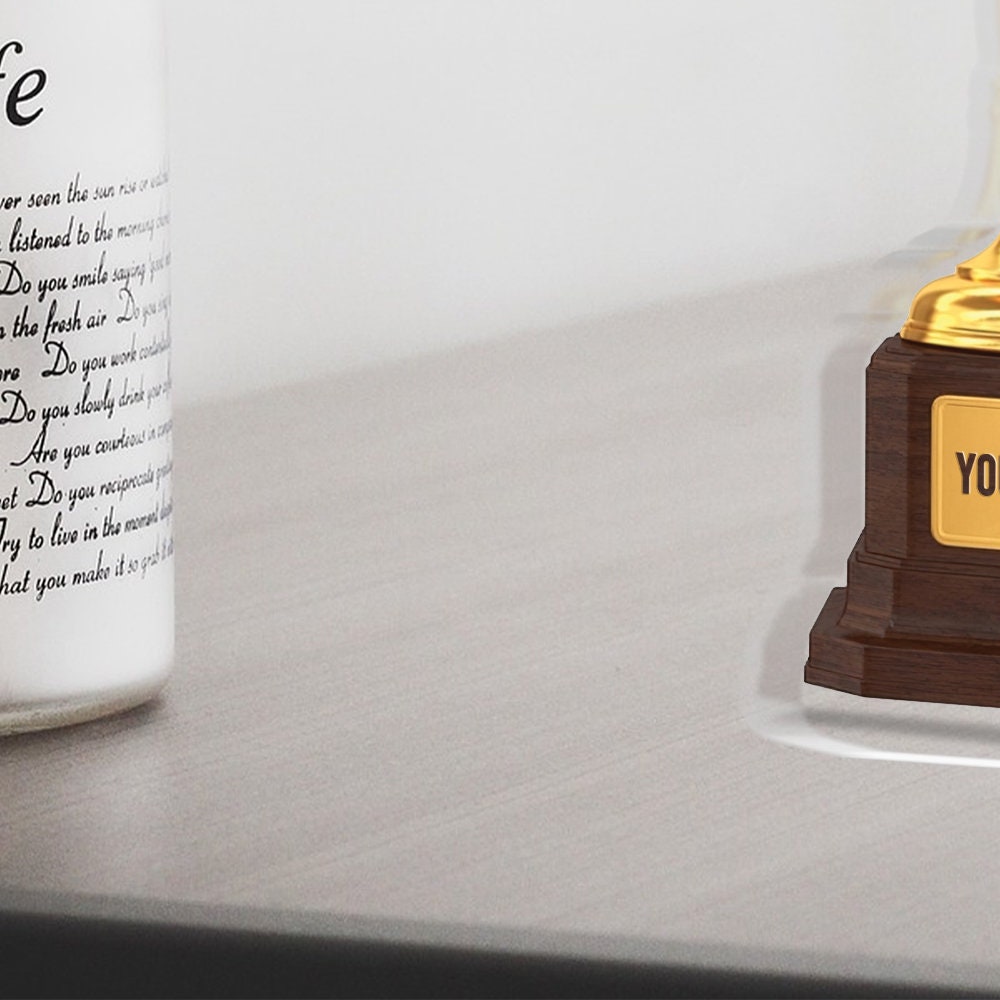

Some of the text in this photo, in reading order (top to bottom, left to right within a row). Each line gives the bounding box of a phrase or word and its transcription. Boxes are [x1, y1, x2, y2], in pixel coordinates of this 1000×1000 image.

[27, 192, 61, 209] seen
[67, 172, 88, 204] the
[93, 185, 115, 201] sun
[9, 215, 74, 253] listened
[77, 222, 90, 245] to
[94, 210, 113, 243] the
[0, 260, 32, 295] Do
[38, 274, 68, 302] you
[72, 250, 108, 289] smile
[112, 259, 146, 288] saying
[12, 304, 39, 338] the
[42, 299, 82, 344] fresh
[86, 309, 107, 329] air
[116, 287, 140, 324] Do
[41, 340, 77, 378] Do
[82, 357, 107, 382] you
[111, 332, 137, 367] work
[0, 389, 36, 424] Do
[42, 404, 69, 428] you
[74, 378, 115, 419] slowly
[119, 373, 145, 407] drink
[10, 427, 57, 466] Are
[64, 443, 91, 470] you
[95, 427, 145, 455] courteous
[26, 470, 63, 507] Do
[69, 486, 95, 511] you
[29, 527, 44, 550] to
[51, 511, 78, 546] live
[83, 522, 98, 542] in
[102, 506, 121, 538] the
[36, 575, 66, 602] you
[72, 549, 110, 586] make
[115, 552, 125, 577] it
[127, 558, 139, 575] so
